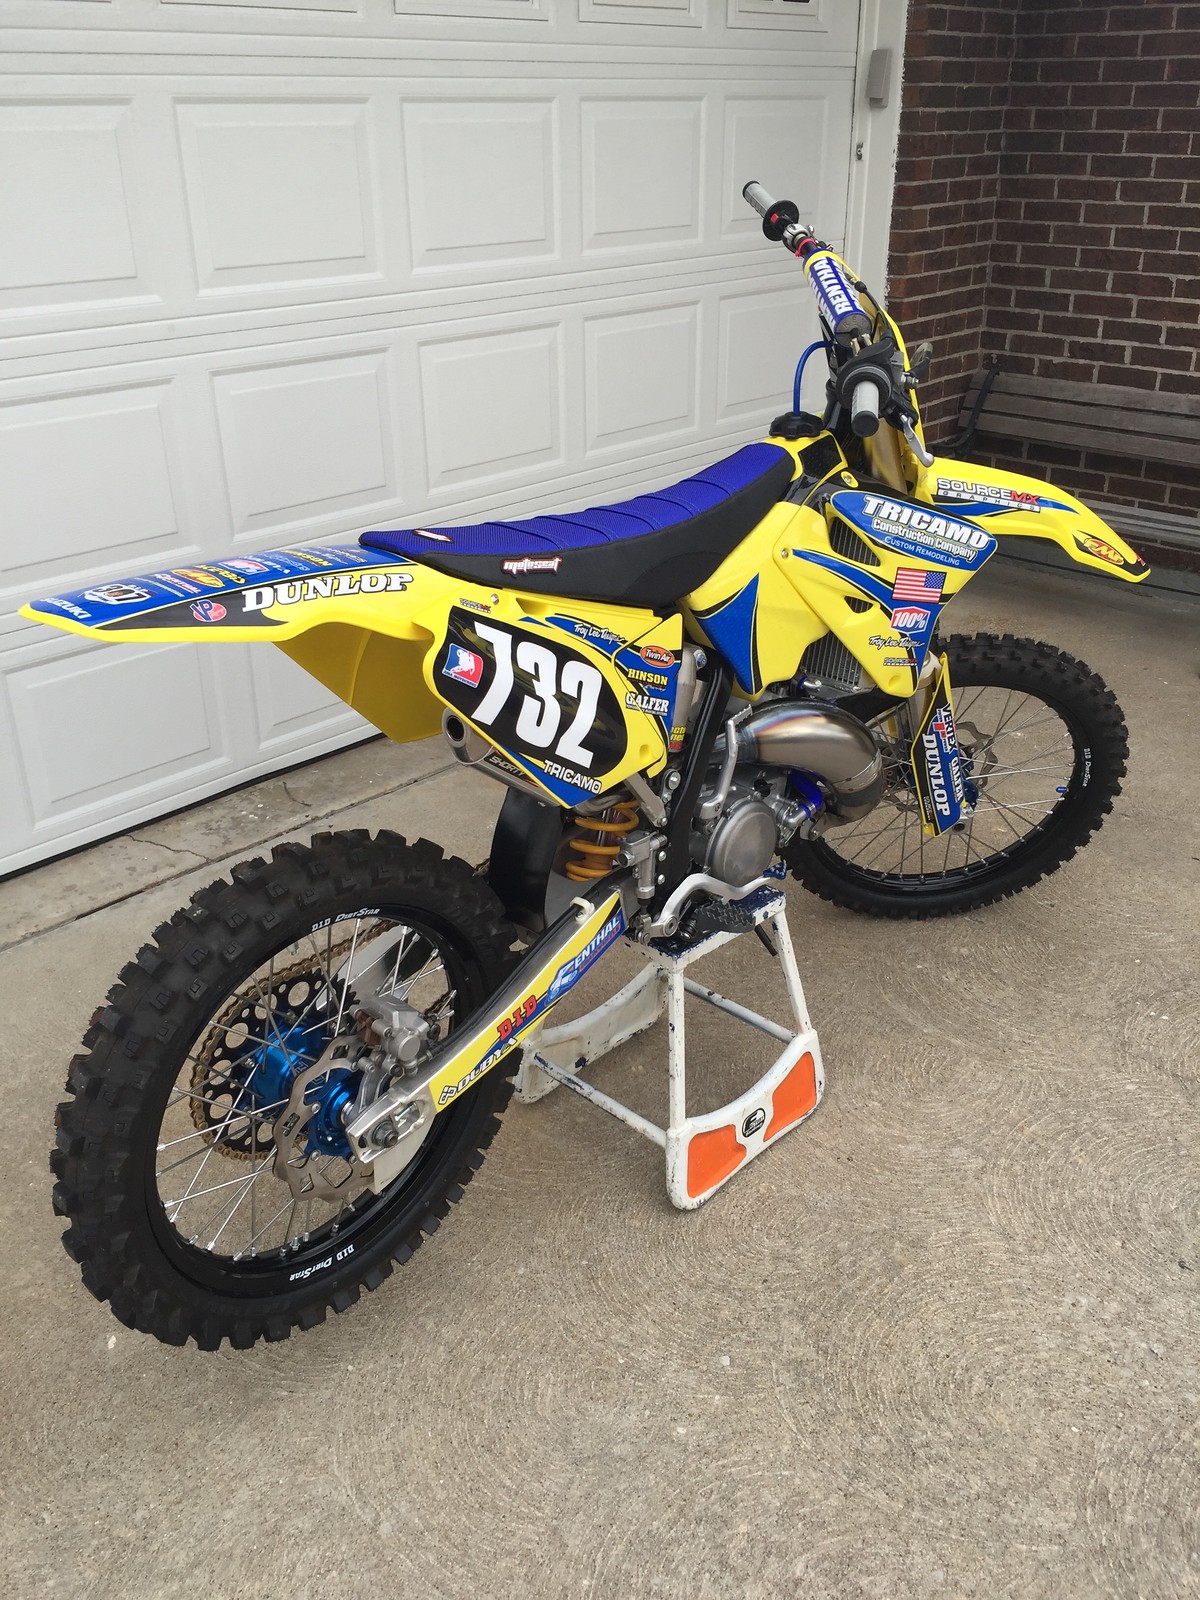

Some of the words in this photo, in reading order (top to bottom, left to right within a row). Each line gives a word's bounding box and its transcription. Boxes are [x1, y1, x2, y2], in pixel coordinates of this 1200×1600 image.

[938, 478, 1040, 505] SOURCEMX
[942, 490, 1036, 512] GRAPHICS
[863, 495, 990, 549] TRICAMO
[873, 518, 935, 548] Construction
[935, 537, 977, 562] Company
[241, 573, 414, 613] DUNLOP
[189, 599, 214, 622] VP
[892, 611, 928, 629] 100%
[574, 624, 588, 639] Troy
[588, 626, 601, 638] Lee
[869, 635, 885, 651] Troy
[885, 636, 899, 648] Lee
[646, 648, 661, 660] Twin
[660, 653, 671, 663] Air
[627, 668, 669, 686] HINSON
[471, 621, 602, 769] 732
[626, 692, 669, 713] GALFER
[942, 703, 958, 754] VERTEX
[489, 755, 525, 777] SHORTY
[543, 760, 602, 795] TRICAMO
[922, 733, 951, 817] DUNLOP
